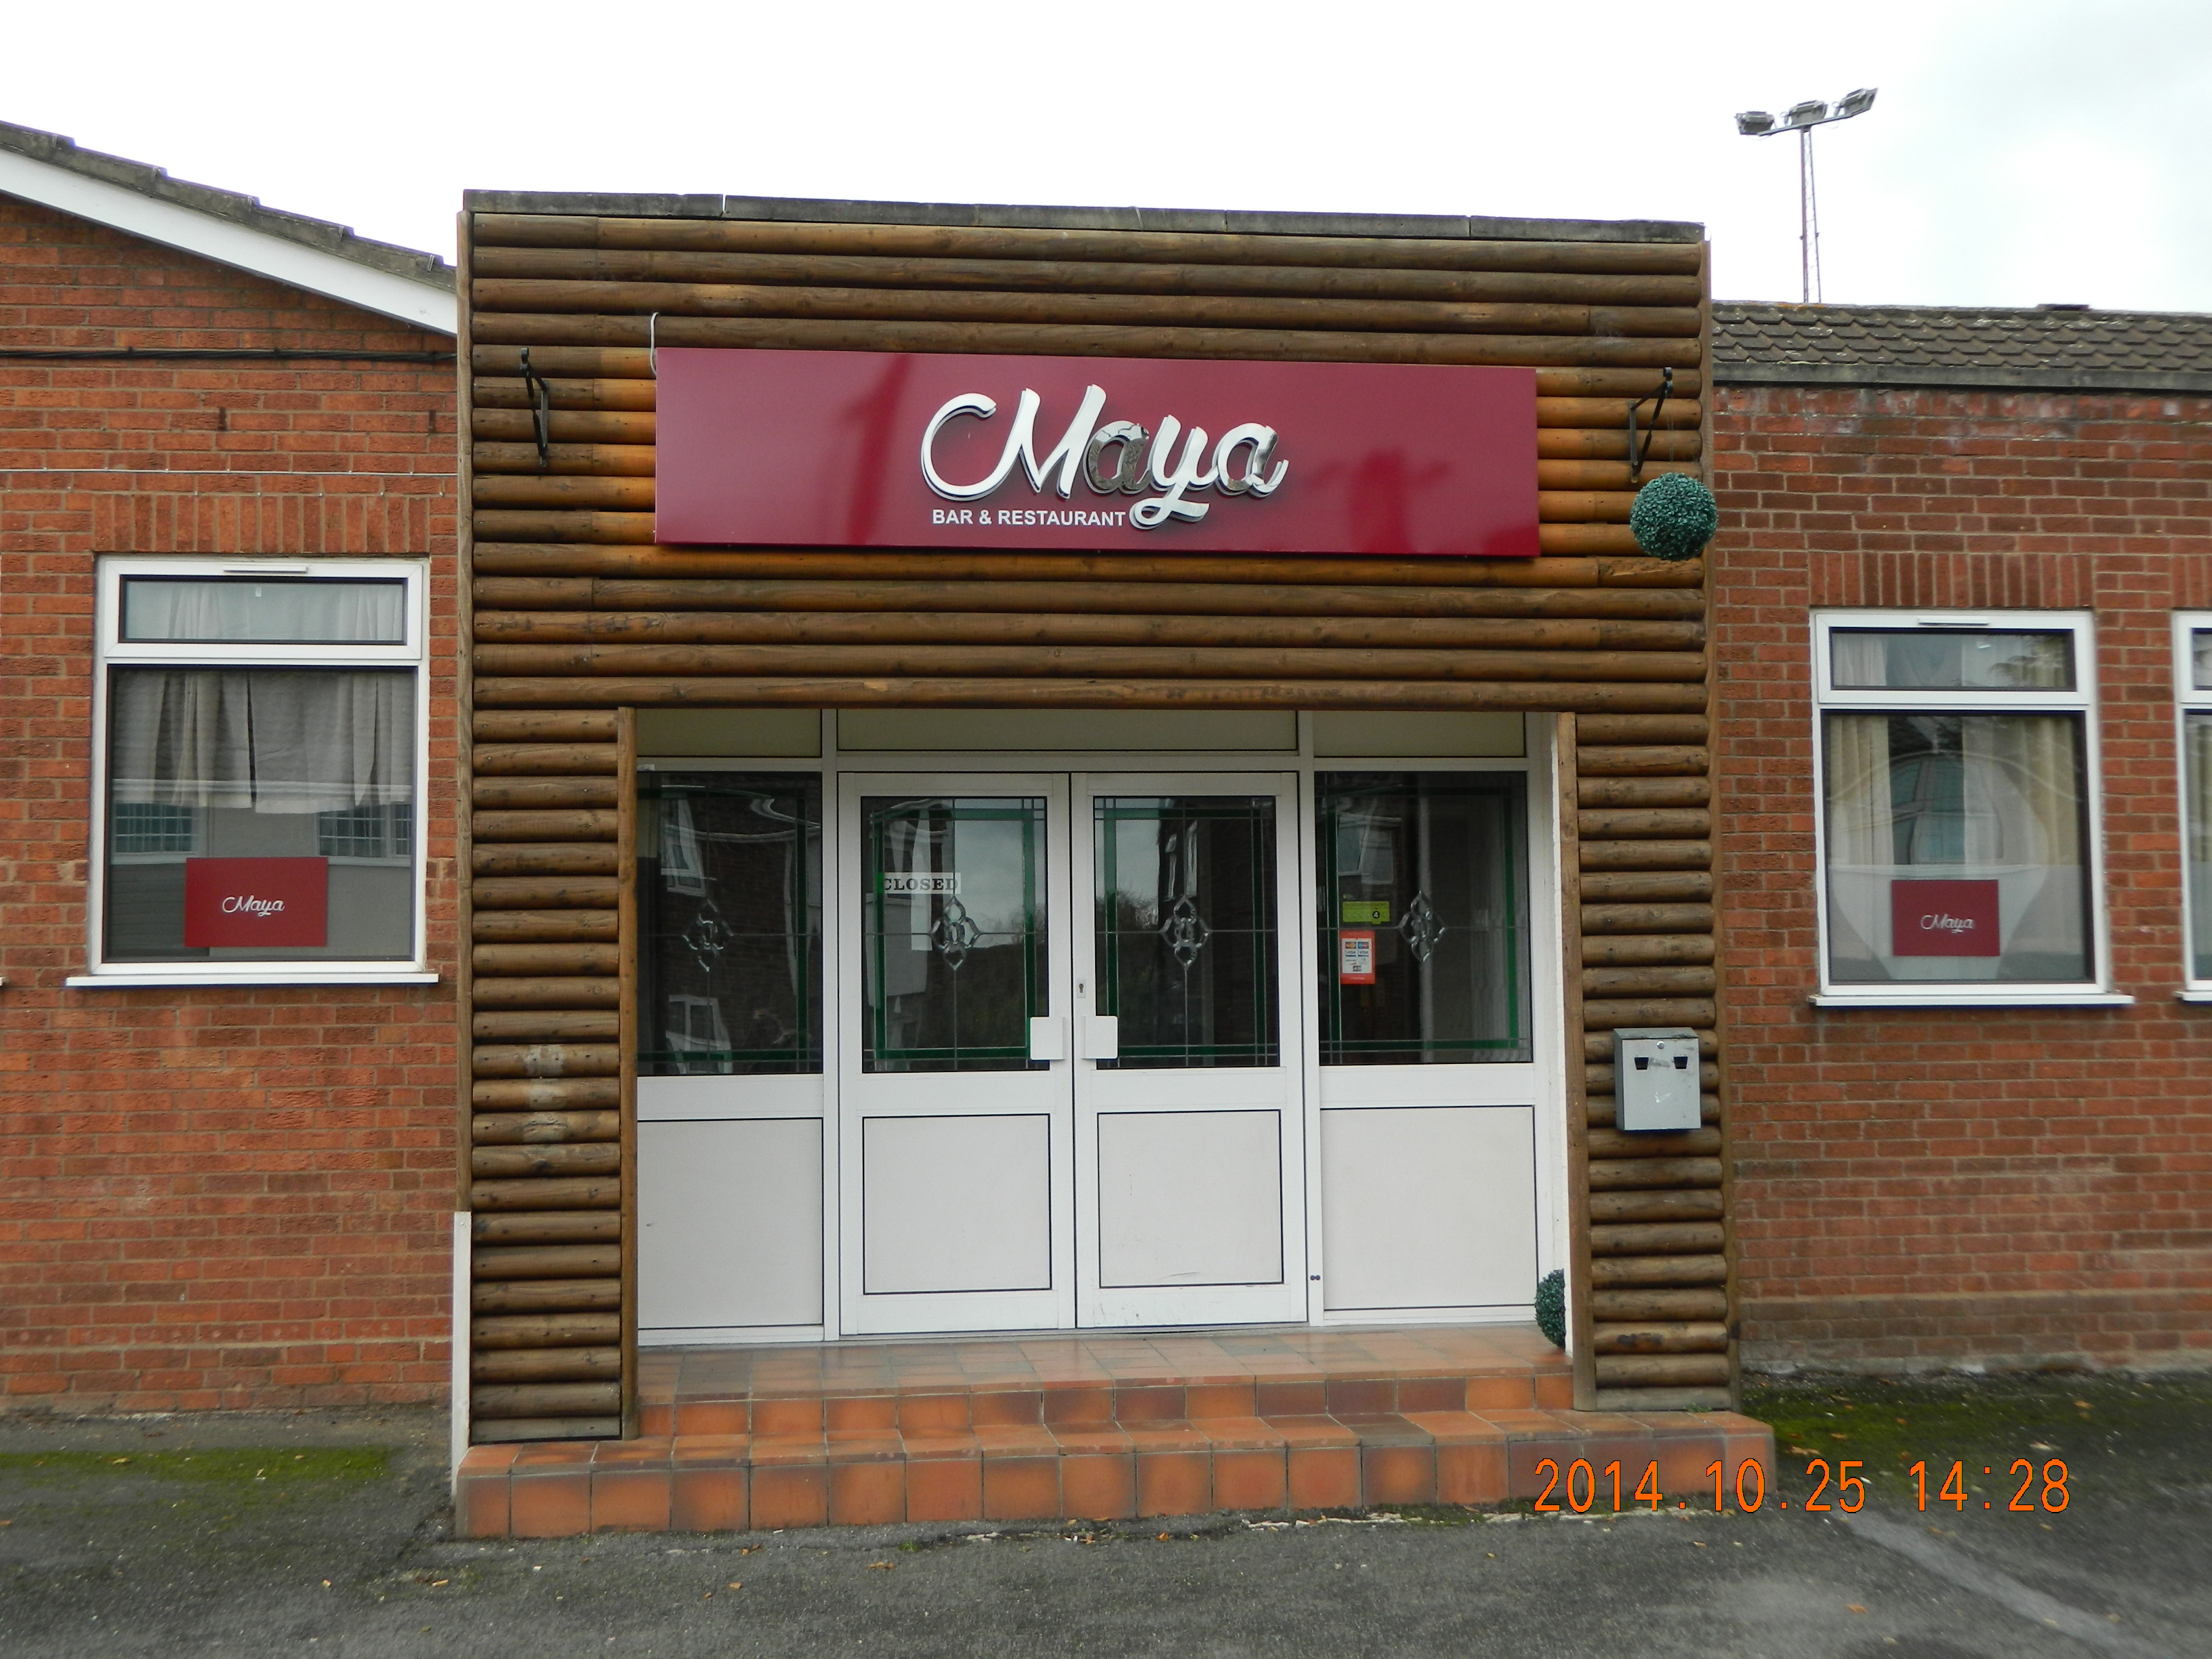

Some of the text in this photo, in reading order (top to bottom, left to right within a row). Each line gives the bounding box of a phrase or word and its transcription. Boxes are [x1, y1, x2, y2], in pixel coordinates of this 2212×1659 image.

[920, 384, 1290, 530] Maya
[932, 509, 1126, 527] BAR & RESTAURANT
[884, 878, 958, 890] CLOSED
[222, 895, 285, 917] Maya
[1921, 914, 1975, 934] Maya
